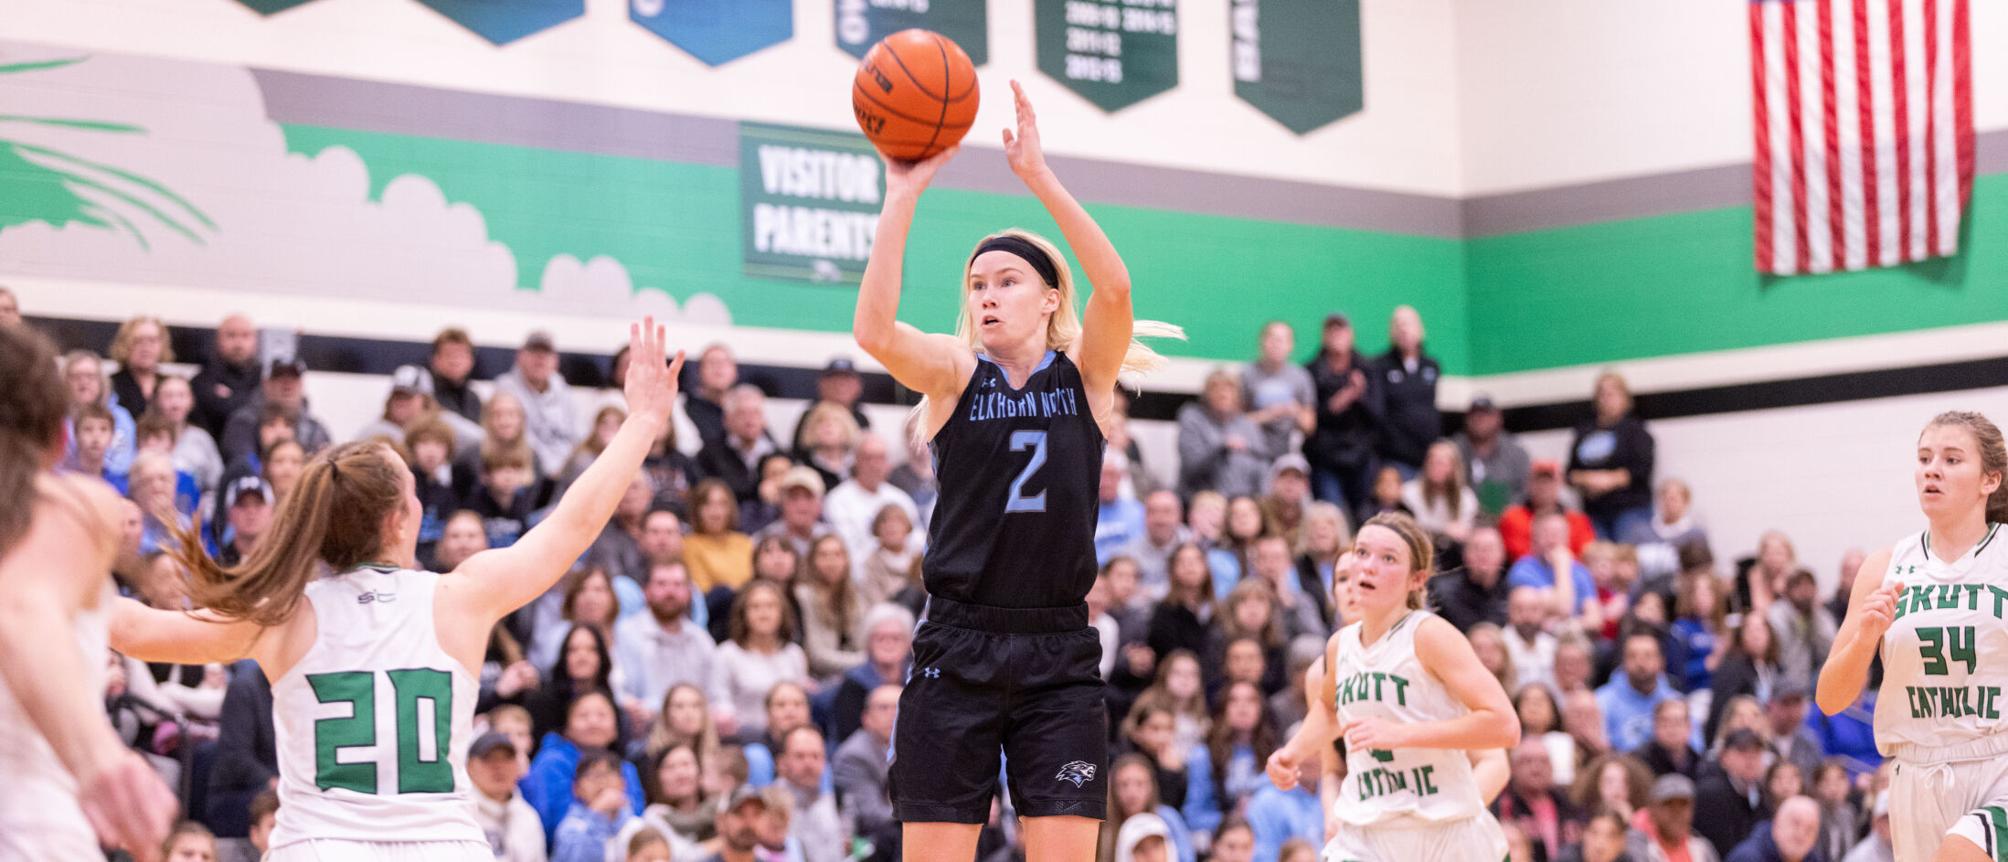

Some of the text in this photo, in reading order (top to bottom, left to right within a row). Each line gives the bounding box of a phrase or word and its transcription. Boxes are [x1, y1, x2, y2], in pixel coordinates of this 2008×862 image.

[758, 144, 880, 204] VISITOR
[969, 390, 1037, 422] ELKHORN
[1004, 429, 1048, 514] 2
[1895, 583, 2008, 621] SKUTT
[1914, 626, 1977, 676] 34
[1336, 671, 1410, 710] KUTT
[1905, 686, 2001, 720] CATHOLIC
[304, 667, 455, 795] 20
[1357, 765, 1439, 801] CATHIC
